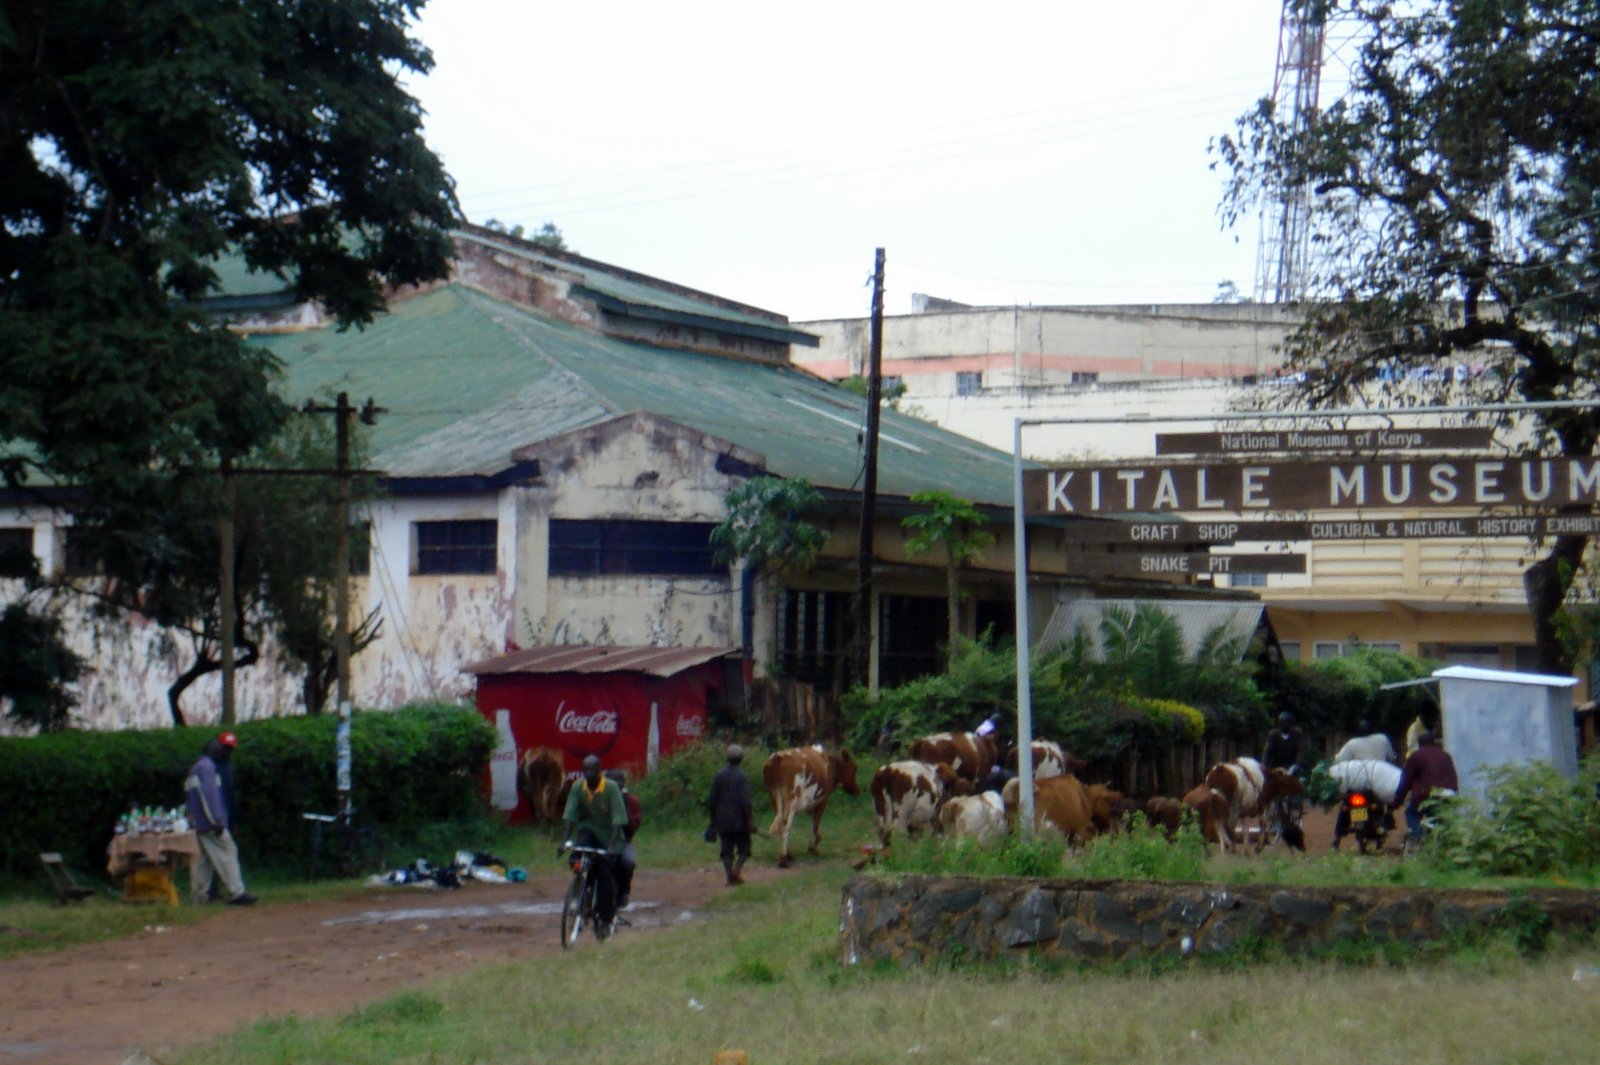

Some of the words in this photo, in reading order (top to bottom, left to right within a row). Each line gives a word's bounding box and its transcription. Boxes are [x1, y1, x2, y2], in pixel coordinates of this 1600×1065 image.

[1221, 433, 1279, 449] National
[1287, 432, 1349, 448] Museums
[1355, 431, 1370, 446] of
[1378, 430, 1422, 448] Kenya
[1047, 466, 1271, 512] KITALE
[1330, 460, 1600, 506] MUSEUM
[1130, 524, 1179, 541] CRAFT
[1199, 523, 1238, 539] SHOP
[1311, 521, 1380, 538] CULTURAL
[1387, 521, 1398, 537] &
[1404, 519, 1466, 537] NATURAL
[1478, 518, 1537, 535] HISTORY
[1140, 556, 1189, 573] SNAKE
[1209, 555, 1231, 572] PIT
